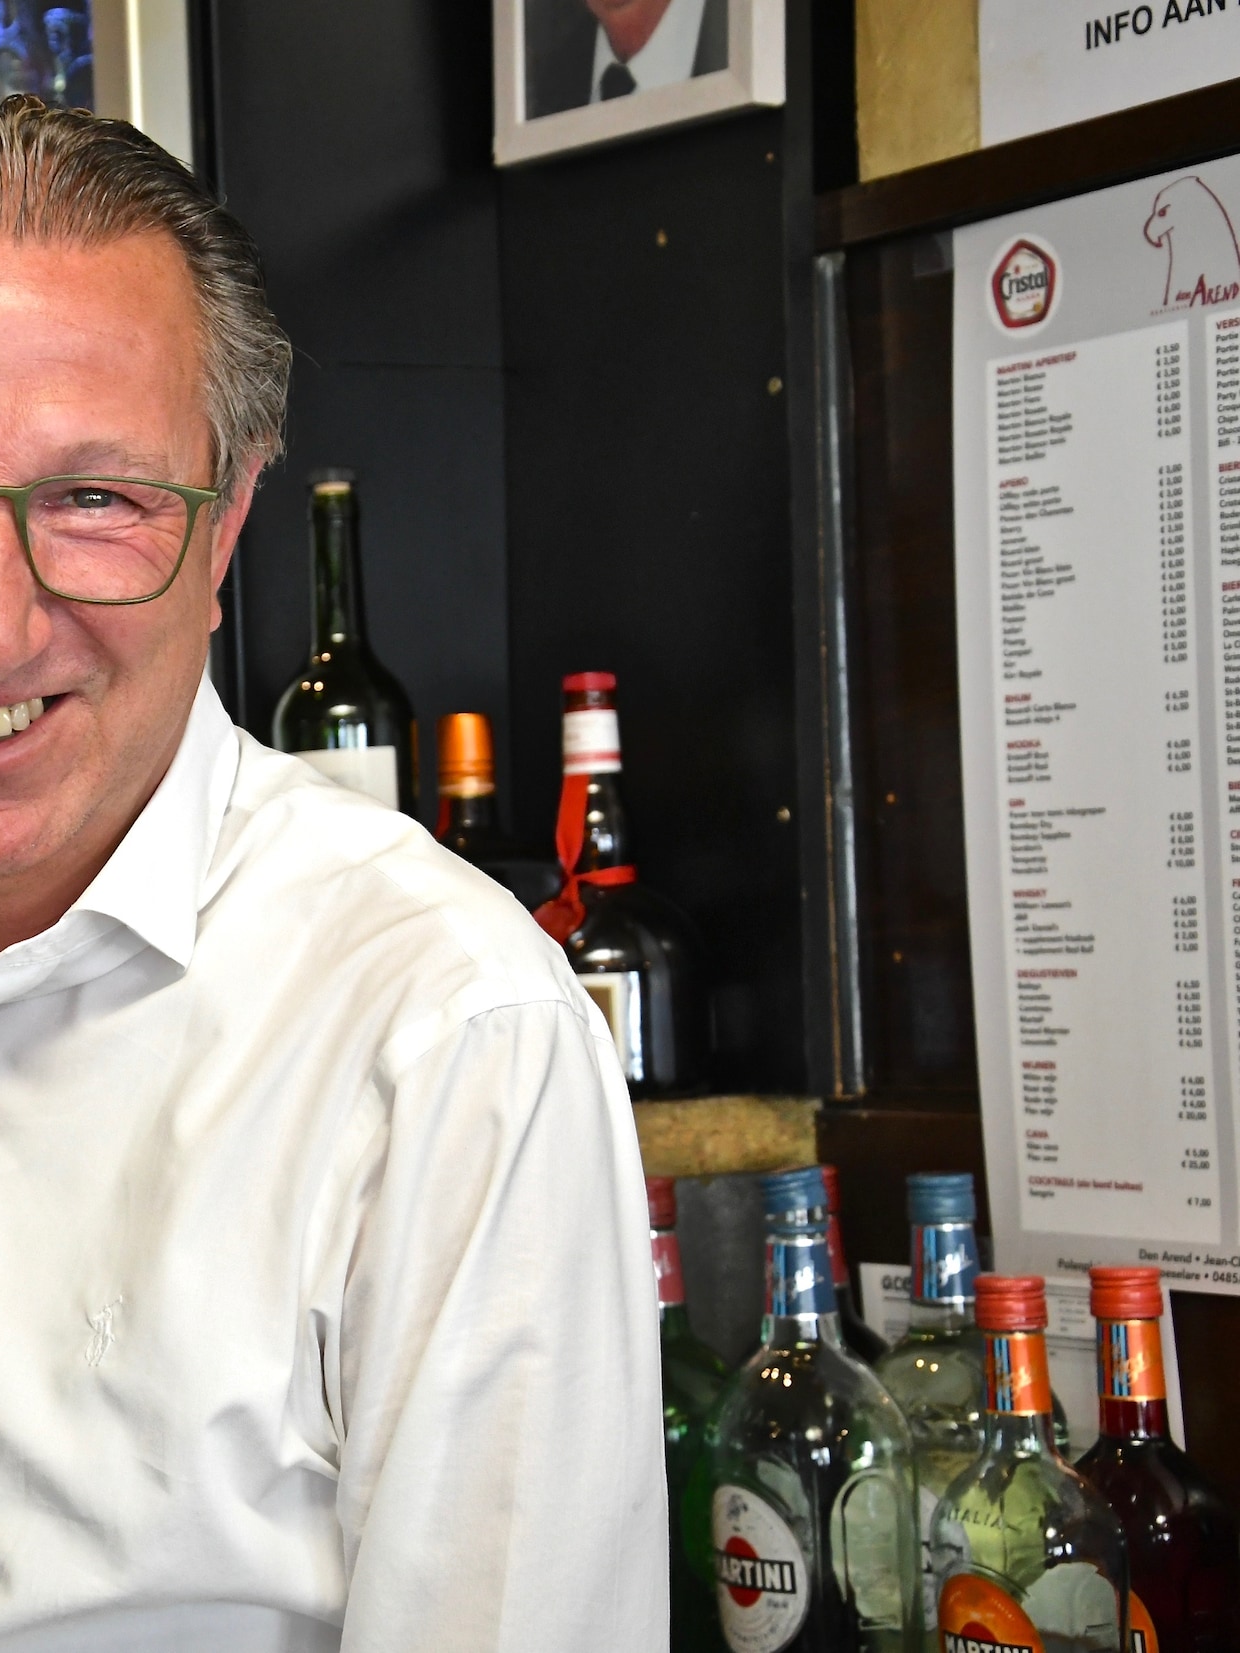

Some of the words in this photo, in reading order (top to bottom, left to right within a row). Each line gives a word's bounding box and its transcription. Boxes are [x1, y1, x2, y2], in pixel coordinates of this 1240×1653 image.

[1086, 5, 1153, 50] INFO
[999, 266, 1048, 301] Cristal
[1218, 416, 1238, 424] Chips
[1138, 1248, 1159, 1260] Den
[1162, 1250, 1193, 1263] Arend
[1159, 1268, 1201, 1280] oeselare
[716, 1555, 793, 1592] ARTINI
[945, 1633, 1031, 1653] MART
